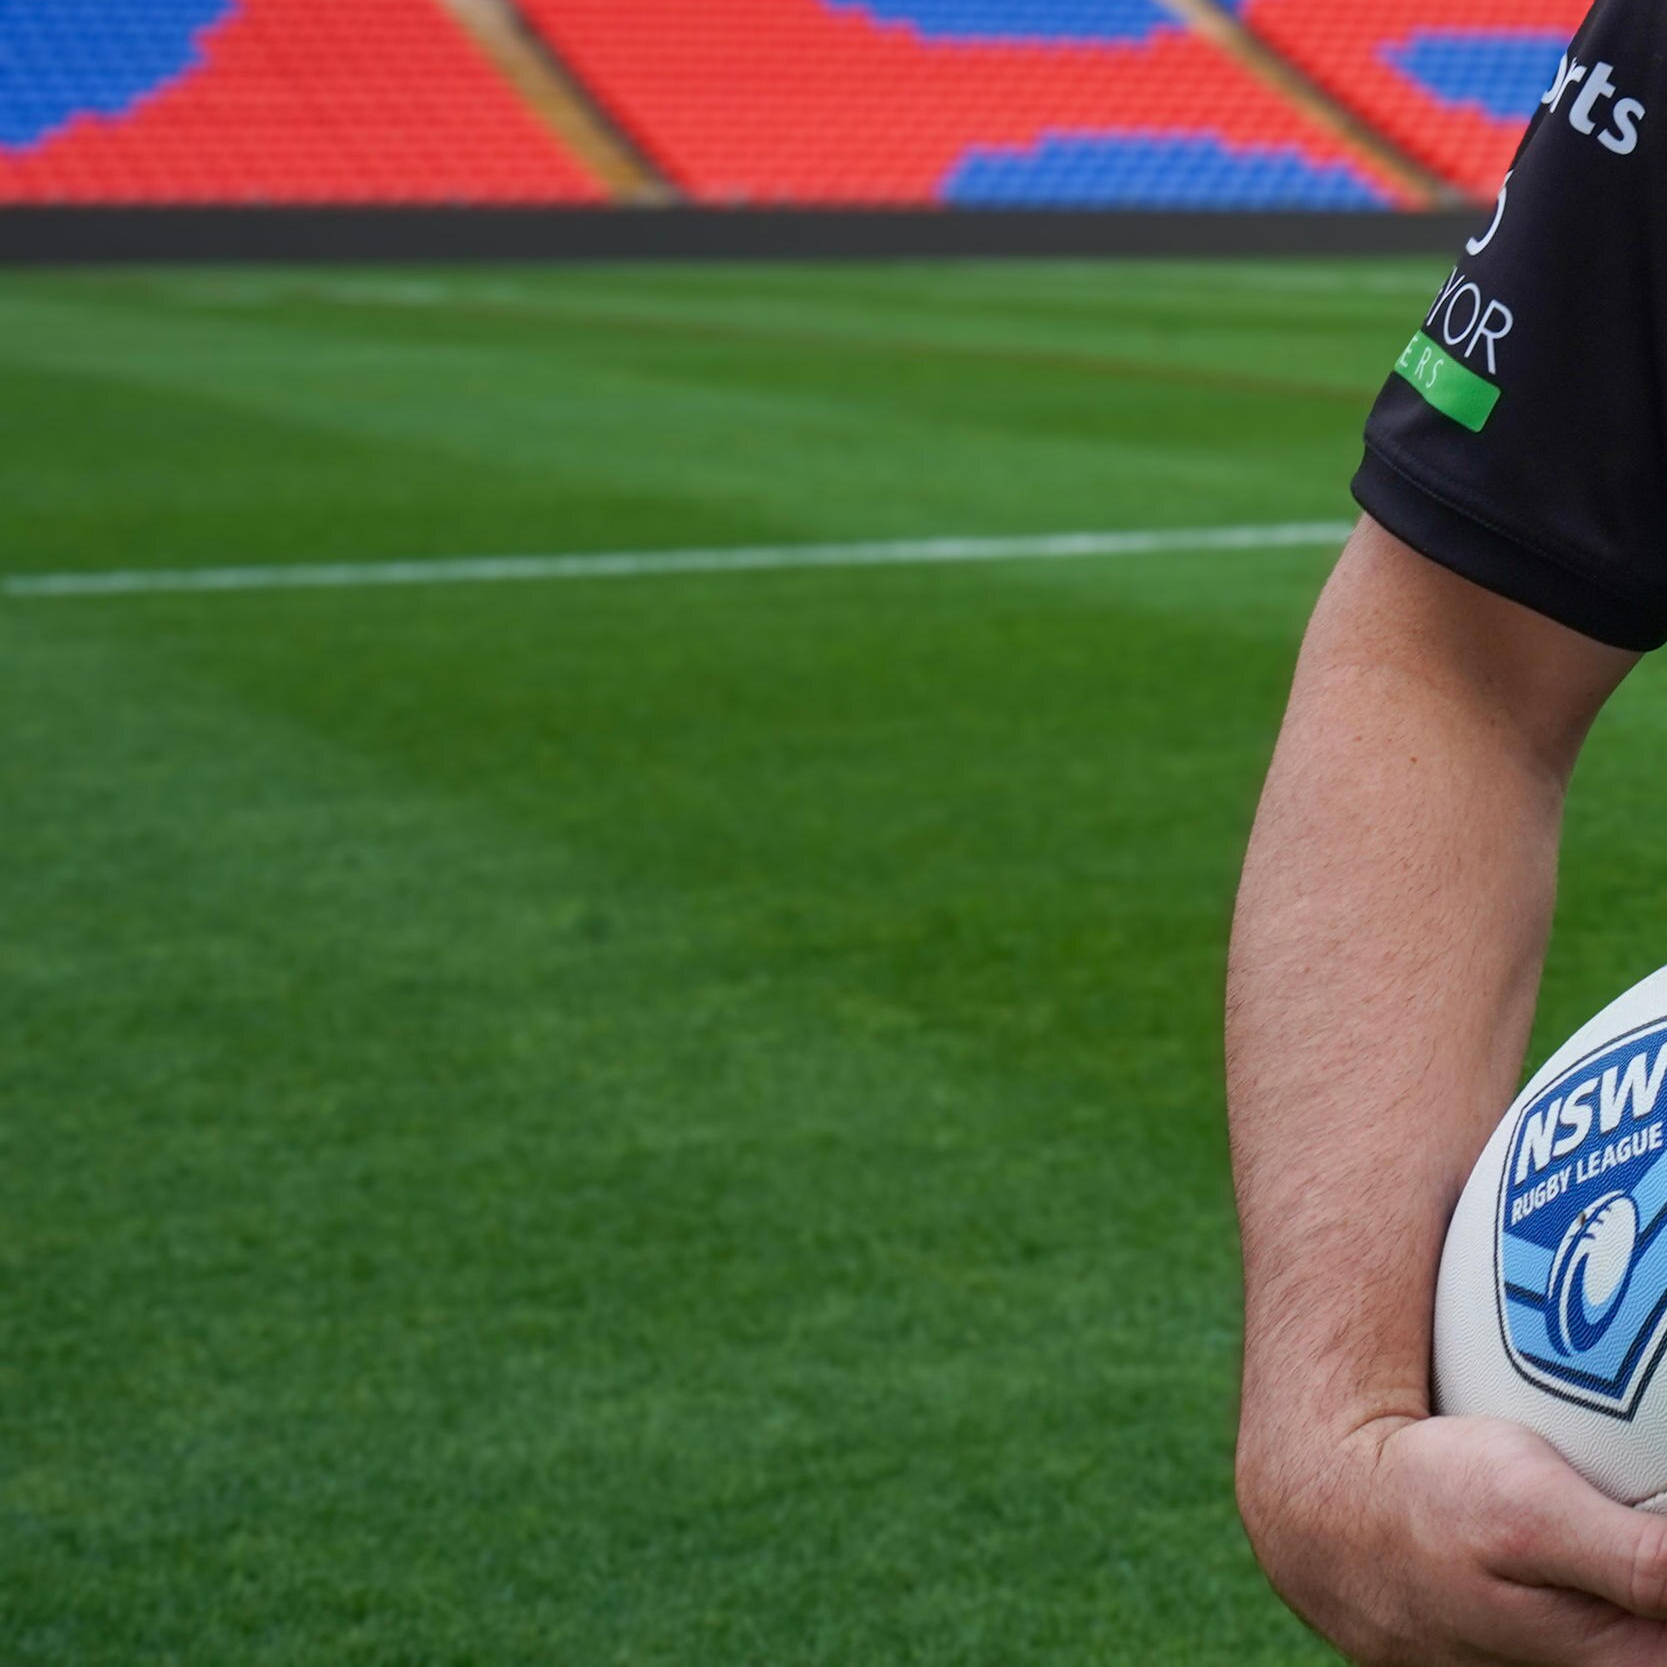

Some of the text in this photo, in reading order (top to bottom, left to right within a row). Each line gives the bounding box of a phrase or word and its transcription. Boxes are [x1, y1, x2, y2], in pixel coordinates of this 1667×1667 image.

[1426, 265, 1514, 376] YOR
[1510, 1121, 1664, 1227] RUGBY LEAGUE
